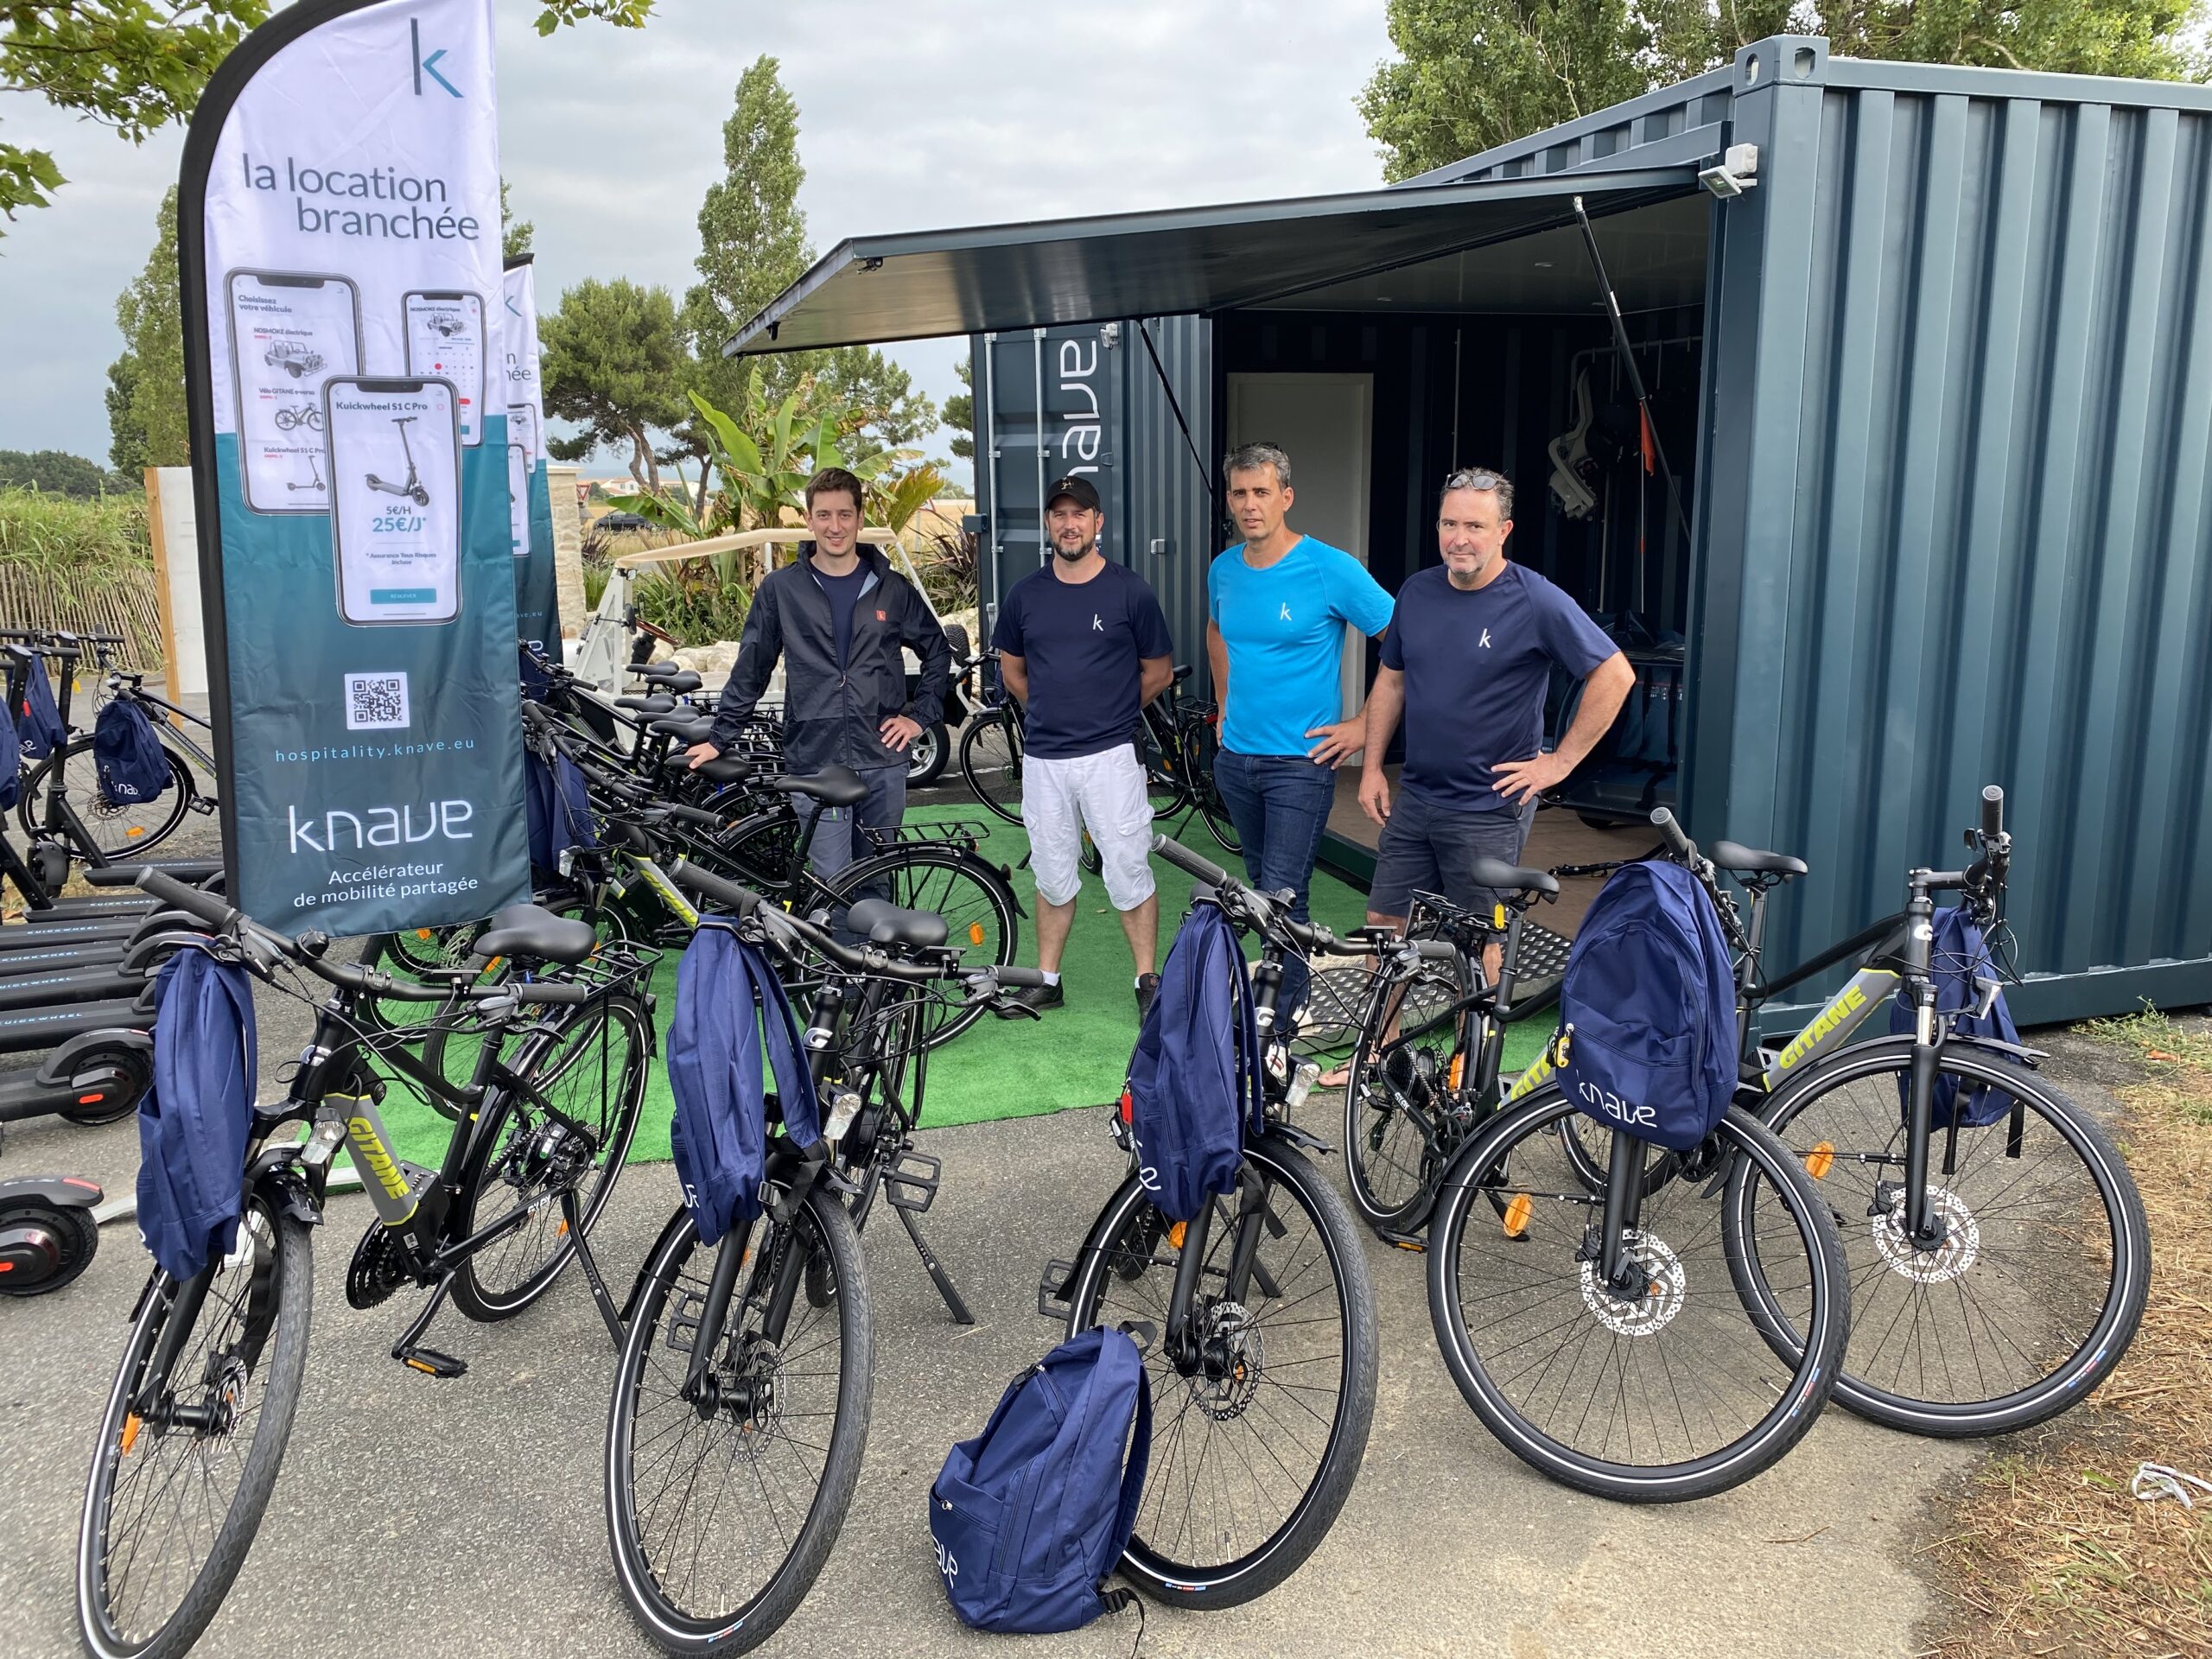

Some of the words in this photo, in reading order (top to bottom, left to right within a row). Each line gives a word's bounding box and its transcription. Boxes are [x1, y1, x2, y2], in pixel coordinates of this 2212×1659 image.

[243, 153, 276, 190] la
[288, 156, 447, 202] location
[297, 197, 480, 241] branchée
[238, 295, 277, 304] Choisissez
[260, 304, 293, 314] véhicule
[335, 402, 391, 410] Kuickwheel
[386, 506, 412, 515] 5€/H
[1279, 602, 1292, 621] k
[1092, 613, 1103, 632] k
[1478, 628, 1491, 649] k
[276, 741, 475, 762] hospitality.knave.eu
[289, 800, 474, 854] knave
[328, 862, 444, 885] Accélérateur
[293, 892, 316, 907] de
[321, 883, 396, 904] mobilité
[400, 875, 479, 899] partagée
[0, 977, 73, 989] UICKWHEEL
[0, 1014, 82, 1026] UICKWHEEL
[1780, 985, 1866, 1069] GITANE
[346, 1116, 410, 1199] GITANE
